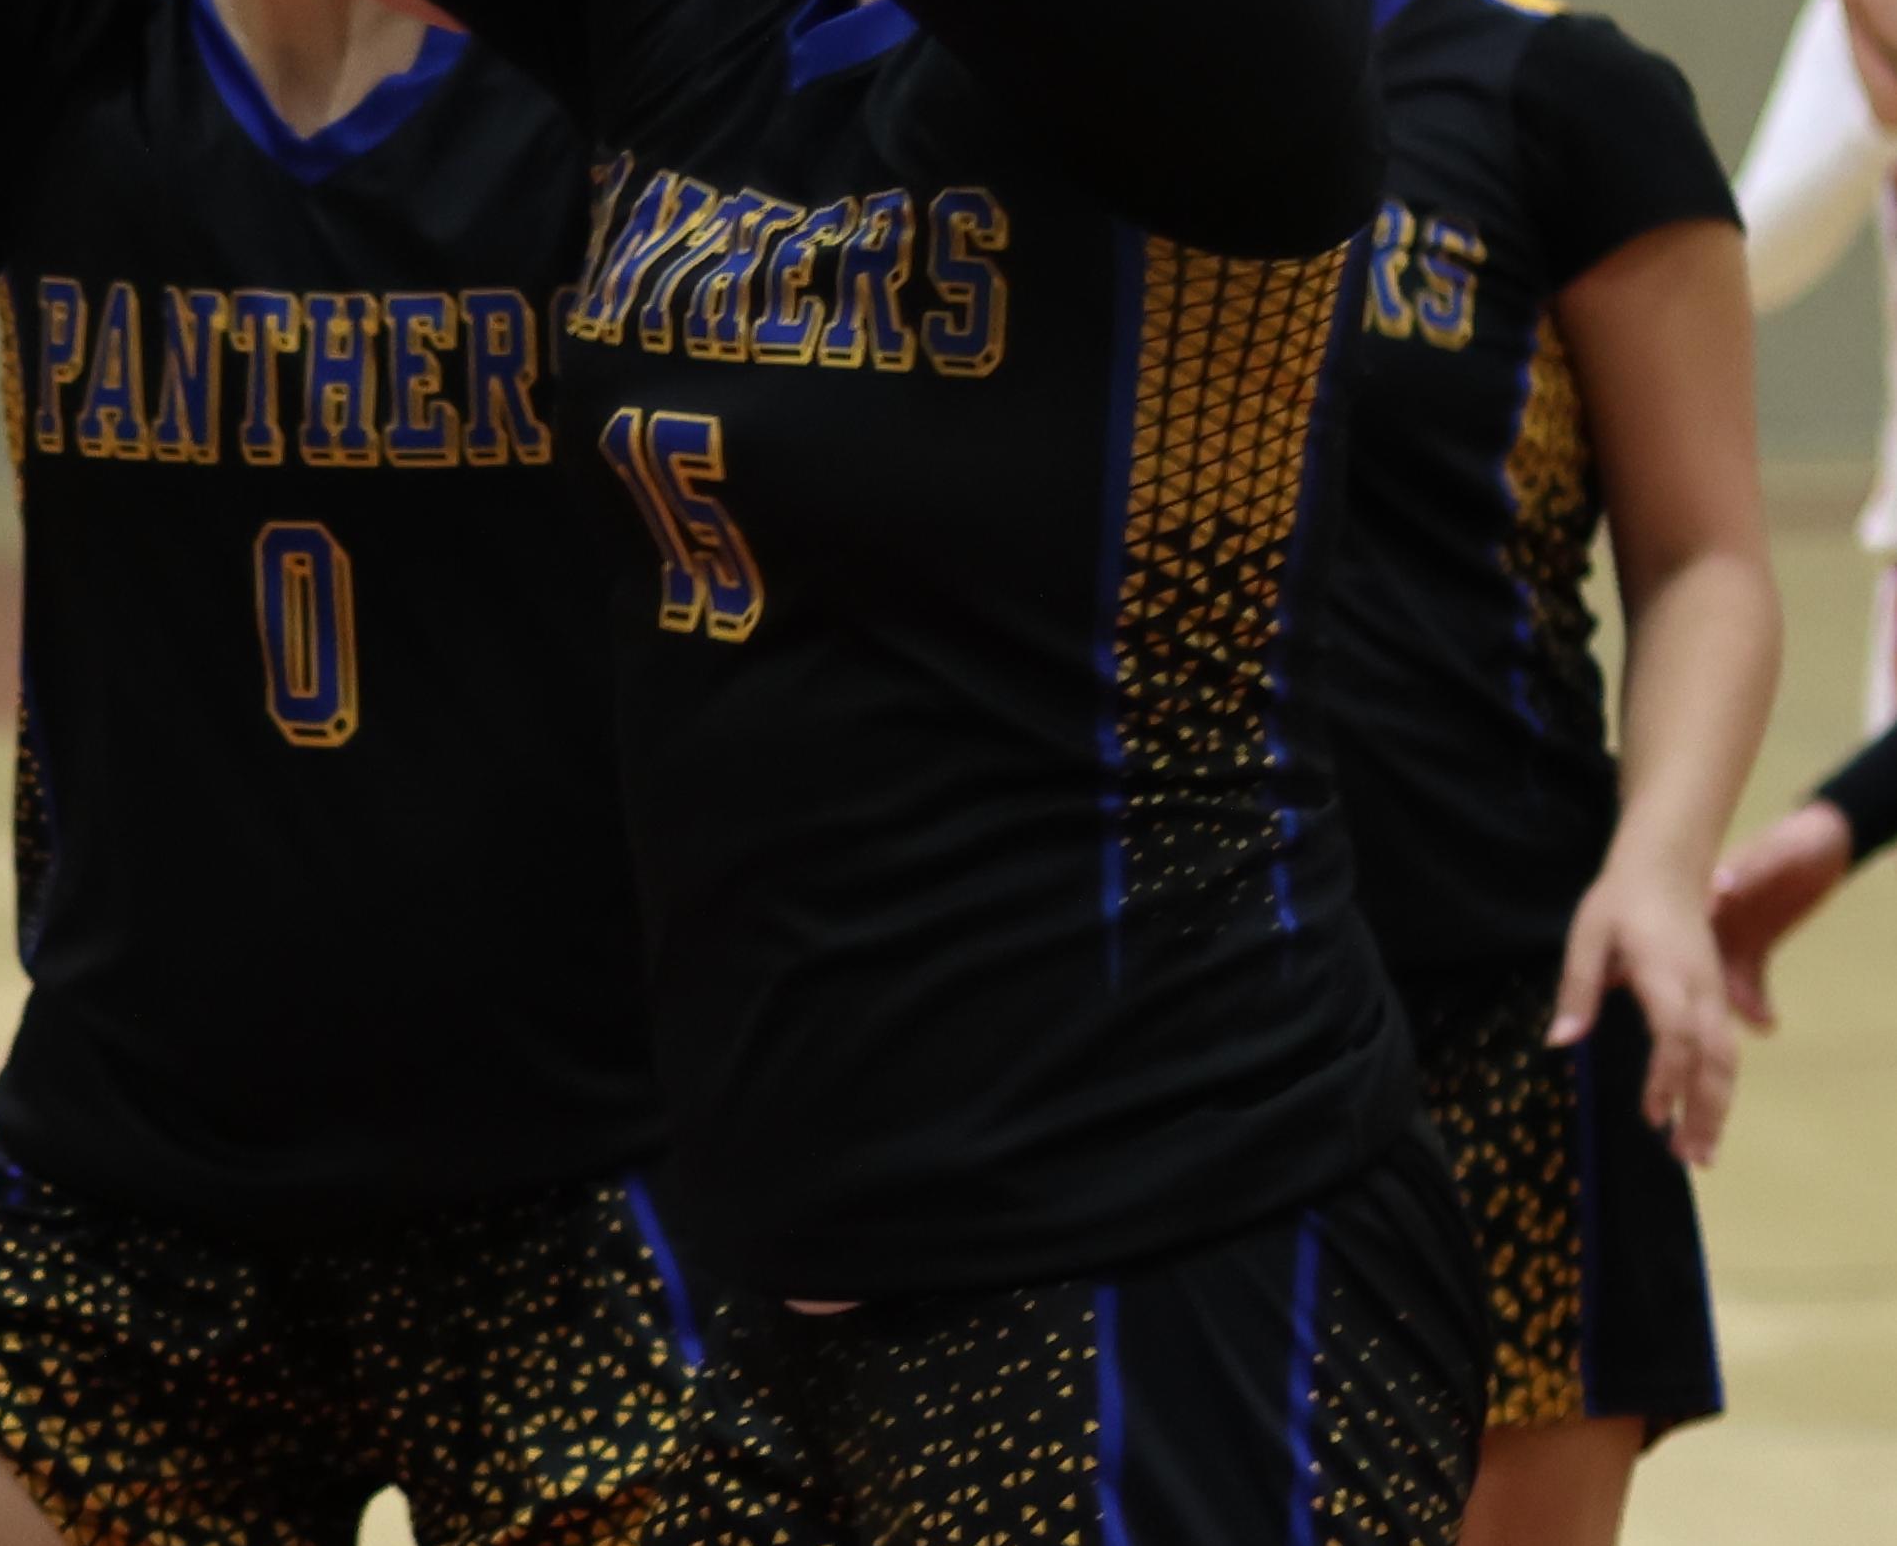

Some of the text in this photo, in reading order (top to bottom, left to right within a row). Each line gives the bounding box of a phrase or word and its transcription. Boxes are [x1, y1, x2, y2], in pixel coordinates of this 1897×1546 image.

[36, 275, 585, 467] PANTHER
[254, 521, 359, 747] 0
[598, 407, 765, 643] 15
